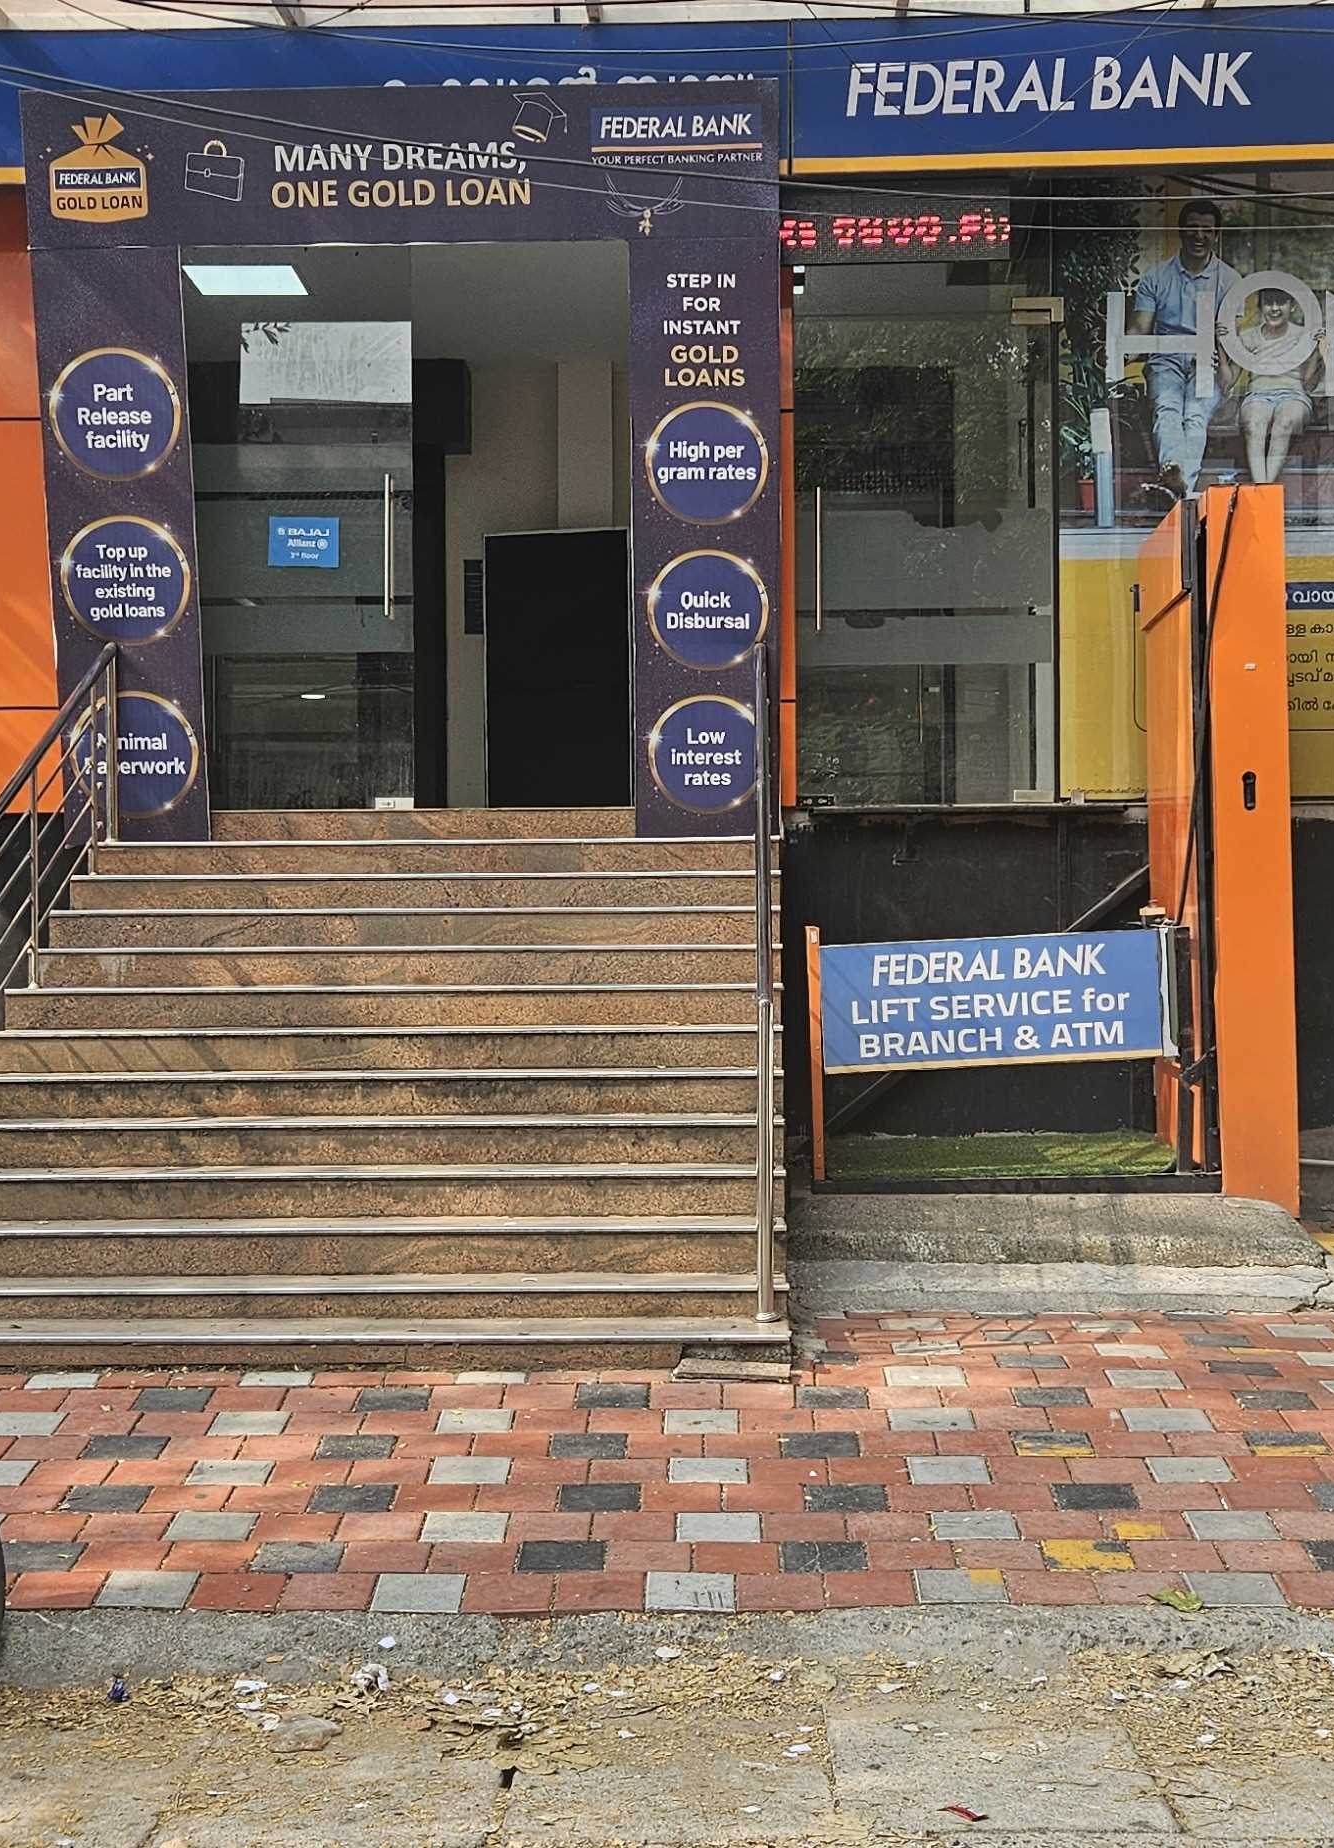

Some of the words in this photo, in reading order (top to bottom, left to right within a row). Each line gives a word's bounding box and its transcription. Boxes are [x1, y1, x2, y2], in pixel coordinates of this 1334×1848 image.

[846, 57, 1076, 117] FEDERAL
[1092, 51, 1254, 110] BANK
[600, 115, 687, 139] FEDERAL
[691, 113, 752, 137] BANK
[274, 143, 377, 174] MANY
[383, 140, 528, 176] DREAMS,
[591, 156, 613, 166] YOUR
[614, 154, 665, 165] PERFECT
[667, 153, 715, 164] BANKING
[717, 152, 763, 163] PARTNER
[59, 172, 103, 185] FEDERAL
[105, 171, 136, 185] BANK
[57, 196, 97, 210] GOLD
[102, 195, 142, 209] LOAN
[271, 180, 338, 210] ONE
[347, 179, 437, 209] GOLD
[445, 178, 532, 206] LOAN
[666, 274, 712, 288] STEP
[717, 273, 736, 288] IN
[682, 296, 720, 312] FOR
[663, 320, 740, 336] INSTANT
[670, 346, 739, 364] GOLD
[664, 368, 745, 387] LOANS
[93, 383, 133, 402] Part
[77, 408, 152, 425] Release
[85, 430, 150, 452] facility
[669, 442, 710, 463] High
[713, 445, 744, 464] per
[657, 466, 704, 484] gram
[709, 464, 756, 481] rates
[288, 528, 330, 537] BAJAJ
[95, 544, 127, 562] Top
[129, 546, 148, 562] up
[75, 563, 128, 581] facility
[129, 564, 144, 578] in
[145, 564, 172, 579] the
[95, 584, 156, 602] existing
[680, 591, 731, 610] Quick
[90, 603, 123, 622] gold
[125, 602, 165, 618] loans
[666, 612, 750, 630] Disbursal
[96, 732, 167, 751] Mnimal
[686, 728, 726, 745] Low
[670, 748, 742, 765] interest
[84, 757, 186, 775] Paerwork
[684, 770, 732, 786] rates
[872, 948, 1005, 987] FEDERAL
[1013, 943, 1106, 978] BANK
[851, 997, 921, 1026] LIFT
[928, 989, 1072, 1020] SERVICE
[1081, 987, 1130, 1013] for
[860, 1025, 1003, 1058] BRANCH
[1014, 1024, 1041, 1050] &
[1050, 1020, 1124, 1048] ATM
